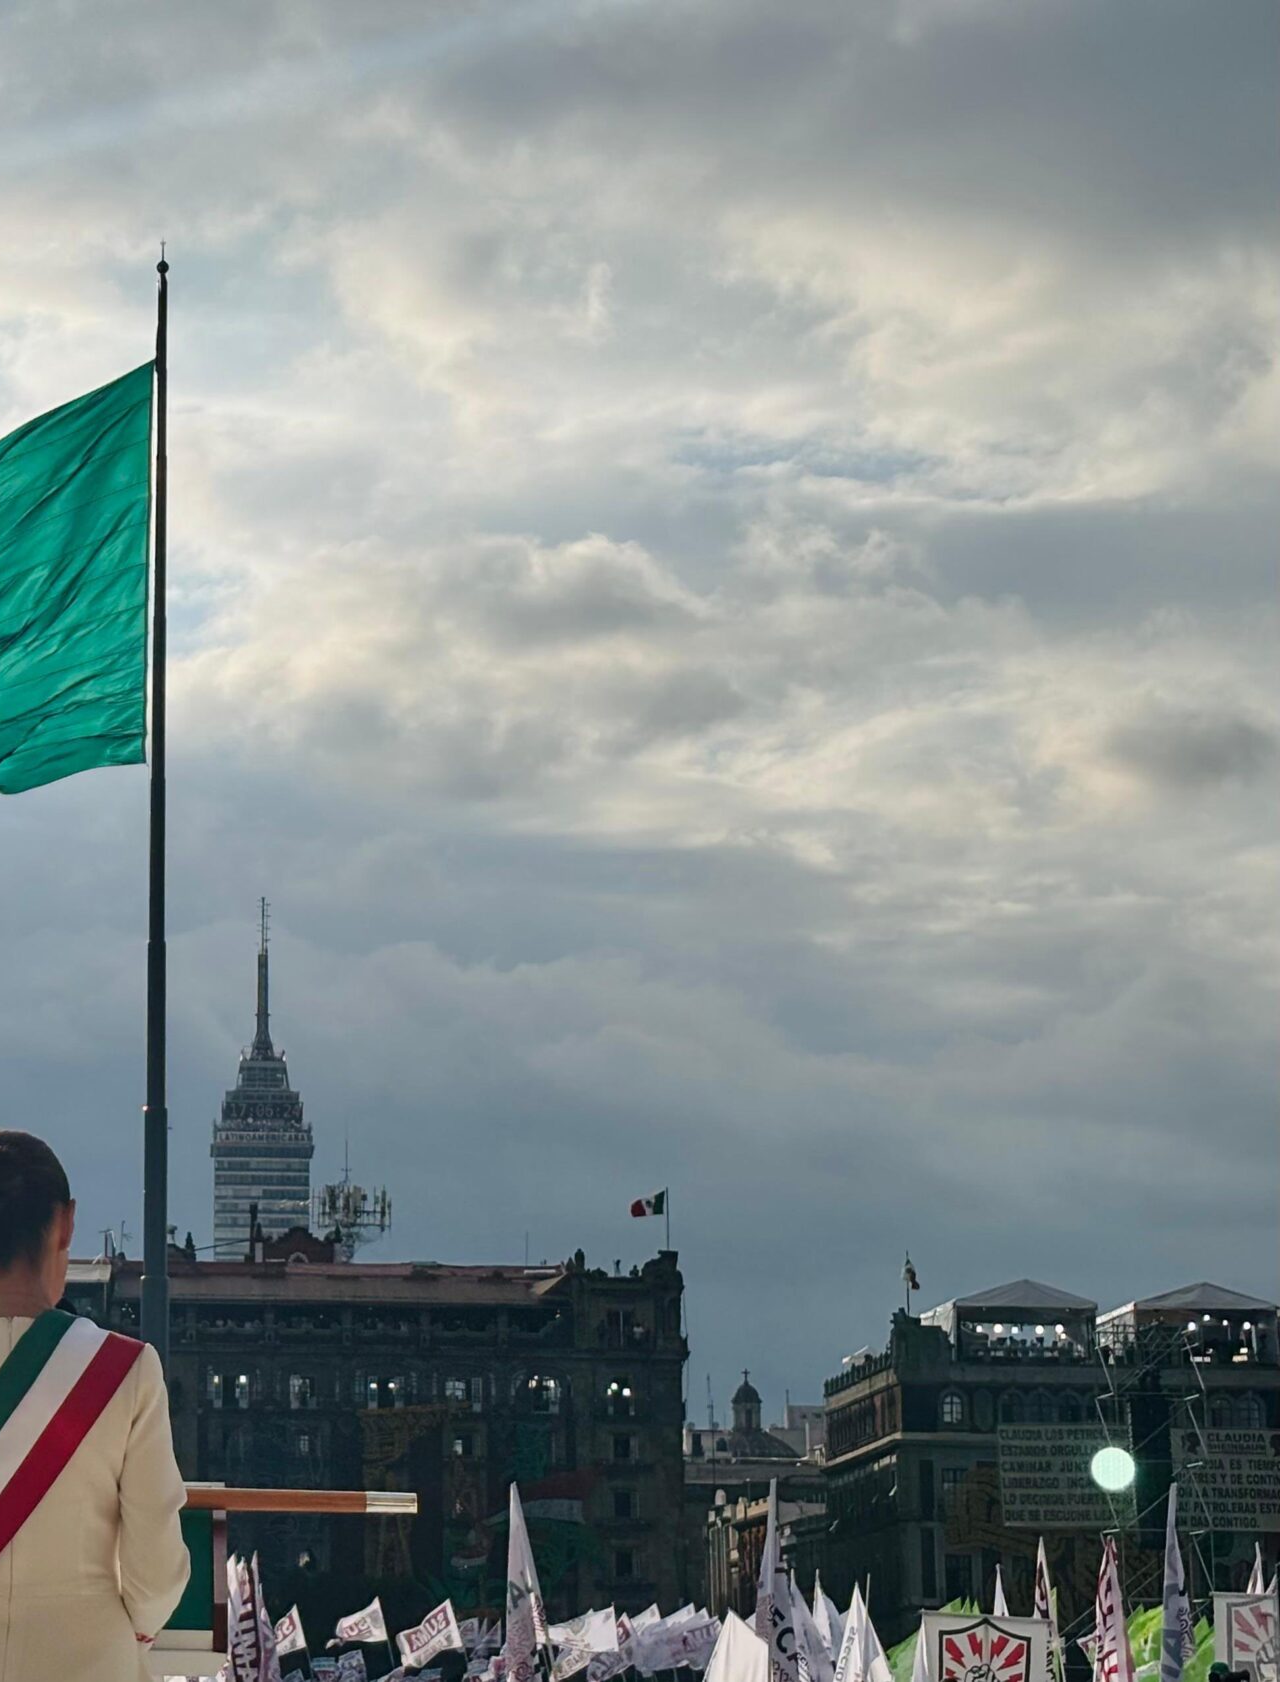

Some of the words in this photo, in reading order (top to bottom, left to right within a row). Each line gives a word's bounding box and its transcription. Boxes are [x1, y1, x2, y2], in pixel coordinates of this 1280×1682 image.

[999, 1429, 1042, 1441] CLAUDIA
[1207, 1433, 1265, 1443] CLAUDIA
[1001, 1445, 1047, 1457] ESTAMOS
[1001, 1461, 1052, 1473] CAMINAR
[1229, 1459, 1242, 1470] ES
[1220, 1473, 1227, 1484] Y
[1230, 1474, 1243, 1485] DE
[1004, 1493, 1016, 1505] LO
[1194, 1502, 1257, 1514] PETROLERAS
[1004, 1509, 1026, 1521] QUE
[1212, 1516, 1260, 1528] CONTIGO.
